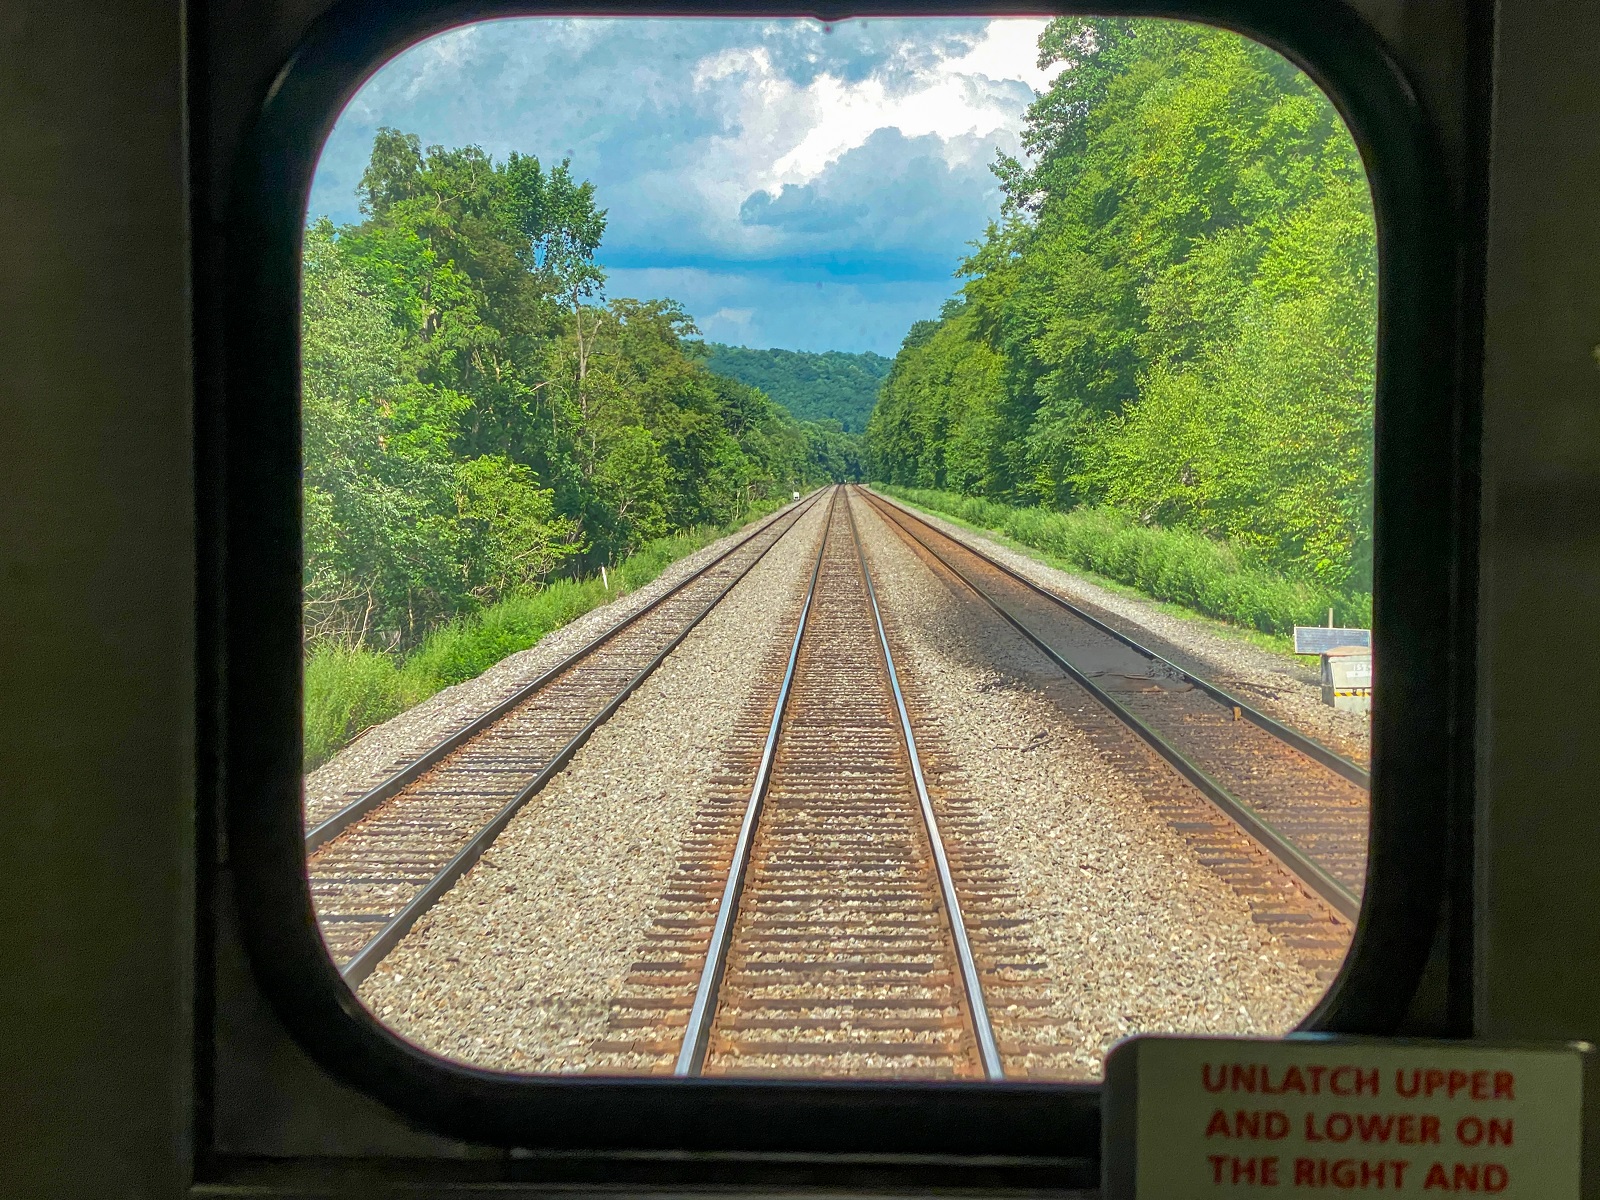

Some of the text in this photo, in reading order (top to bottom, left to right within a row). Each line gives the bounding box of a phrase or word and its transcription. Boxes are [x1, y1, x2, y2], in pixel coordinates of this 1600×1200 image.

[1202, 1064, 1515, 1100] UNLATCH UPPER
[1205, 1110, 1515, 1147] AND LOWER ON
[1208, 1155, 1509, 1193] THE RIGHT AND
